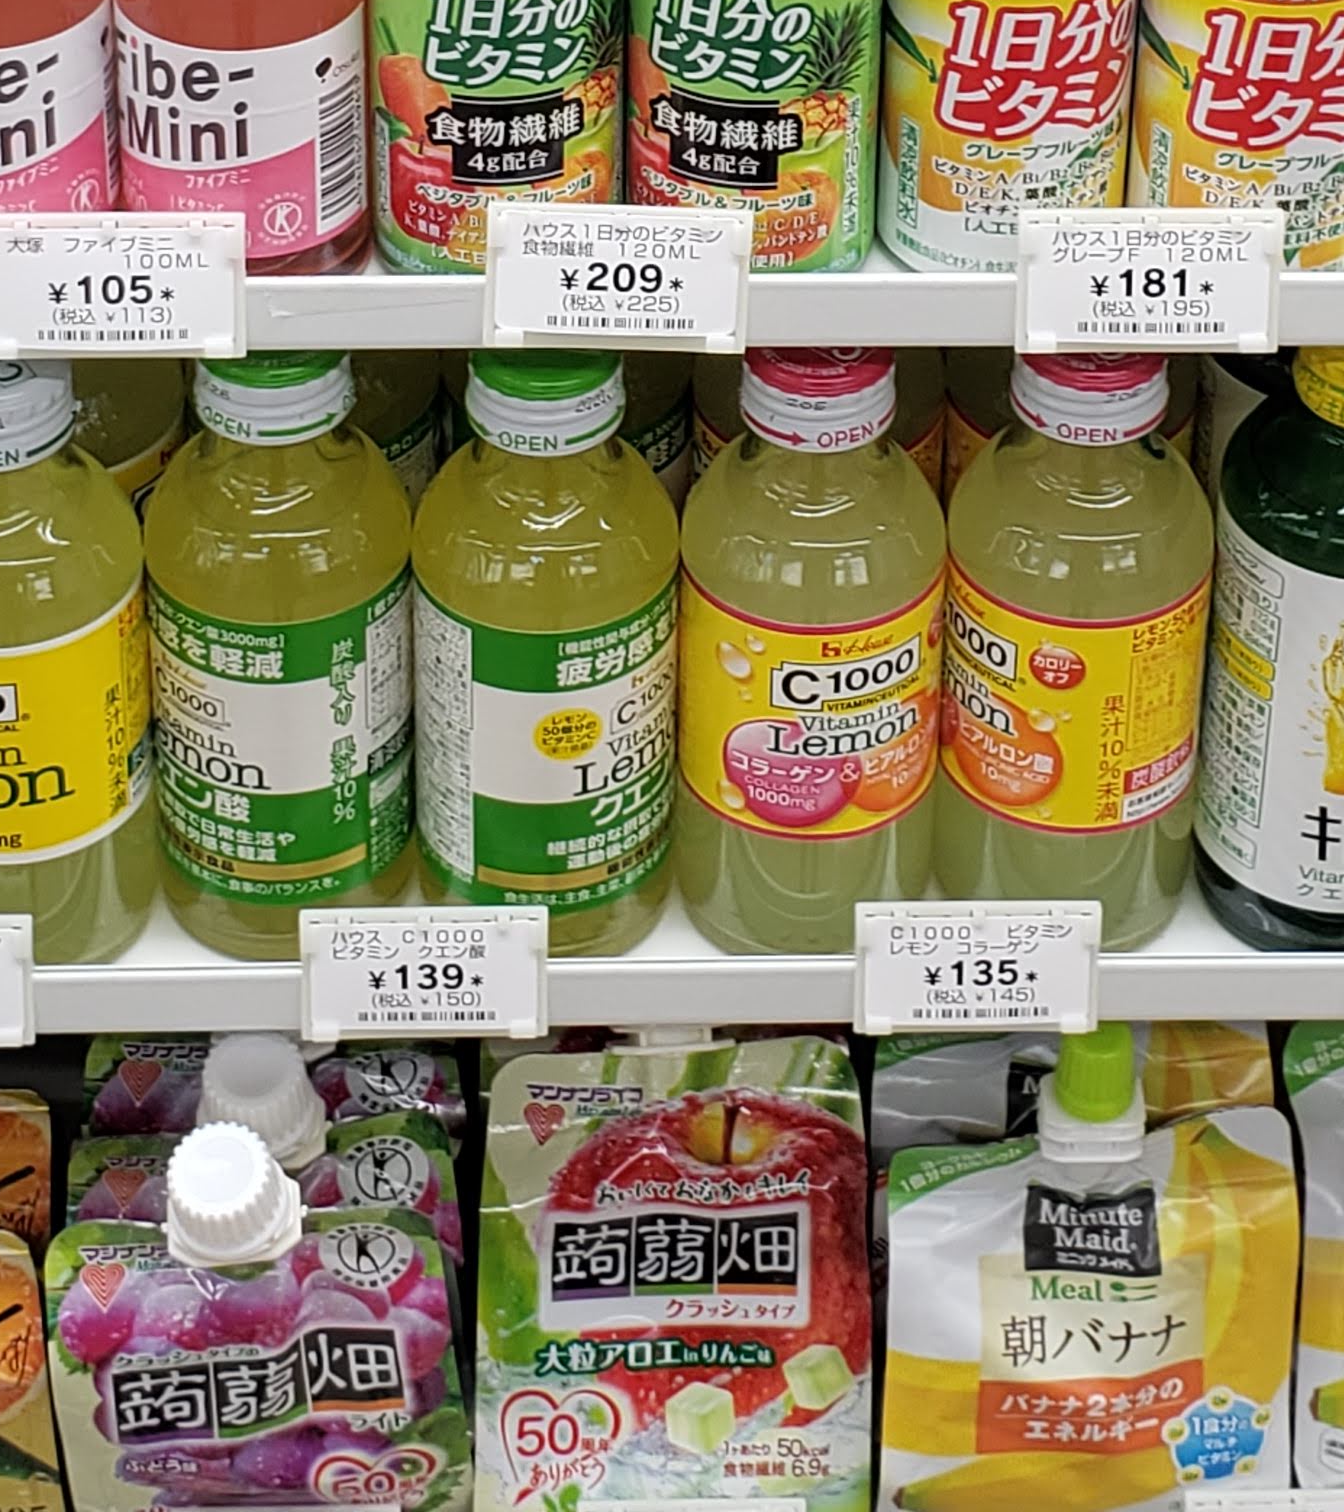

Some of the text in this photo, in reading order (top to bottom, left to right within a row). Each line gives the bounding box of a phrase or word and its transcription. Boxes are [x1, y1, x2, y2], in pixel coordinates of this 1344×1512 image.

[426, 37, 586, 86] ビタミン
[652, 31, 806, 90] ビタミン
[429, 103, 581, 146] 食物繊維
[655, 99, 799, 149] 食物繊維
[468, 149, 550, 176] 4g配合
[1145, 299, 1210, 318] ¥195)
[499, 431, 558, 451] OPEN
[818, 423, 875, 448] OPEN
[781, 648, 916, 705] C1000
[768, 704, 918, 757] Lemon
[730, 749, 837, 783] コラーゲン
[1040, 1199, 1142, 1227] Minute
[555, 1210, 796, 1283] 蒟蒻畑
[1031, 1276, 1103, 1302] Meal
[1002, 1314, 1187, 1366] 朝バナナ
[119, 1344, 401, 1434] 蒟蒻畑
[1000, 1376, 1183, 1416] バナナ2本分の
[516, 1414, 578, 1456] 50
[1024, 1417, 1159, 1442] エネルギー
